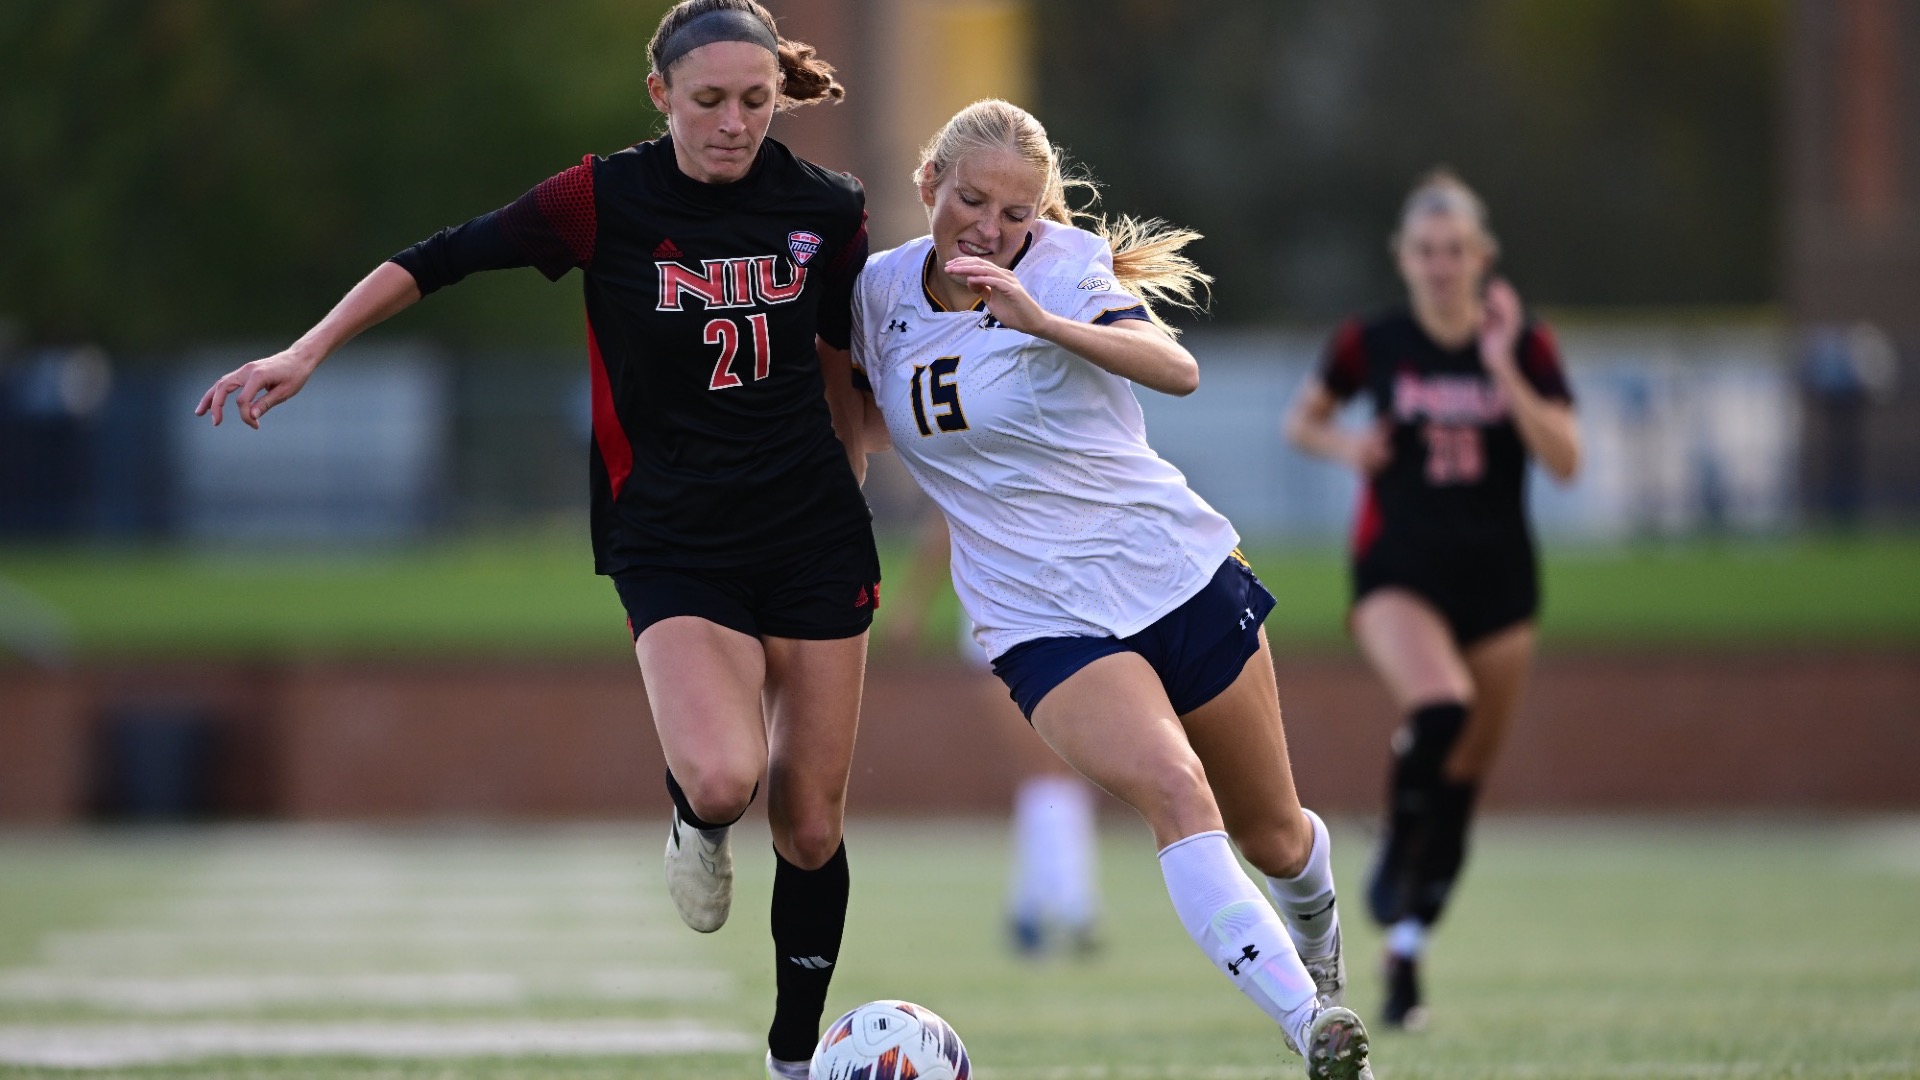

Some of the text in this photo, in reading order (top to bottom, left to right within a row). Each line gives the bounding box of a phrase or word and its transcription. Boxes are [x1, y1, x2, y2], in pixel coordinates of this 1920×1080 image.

[652, 249, 684, 258] adidas
[790, 240, 818, 254] MAC
[654, 255, 808, 311] NIU
[703, 313, 770, 390] 21
[910, 355, 970, 438] 15
